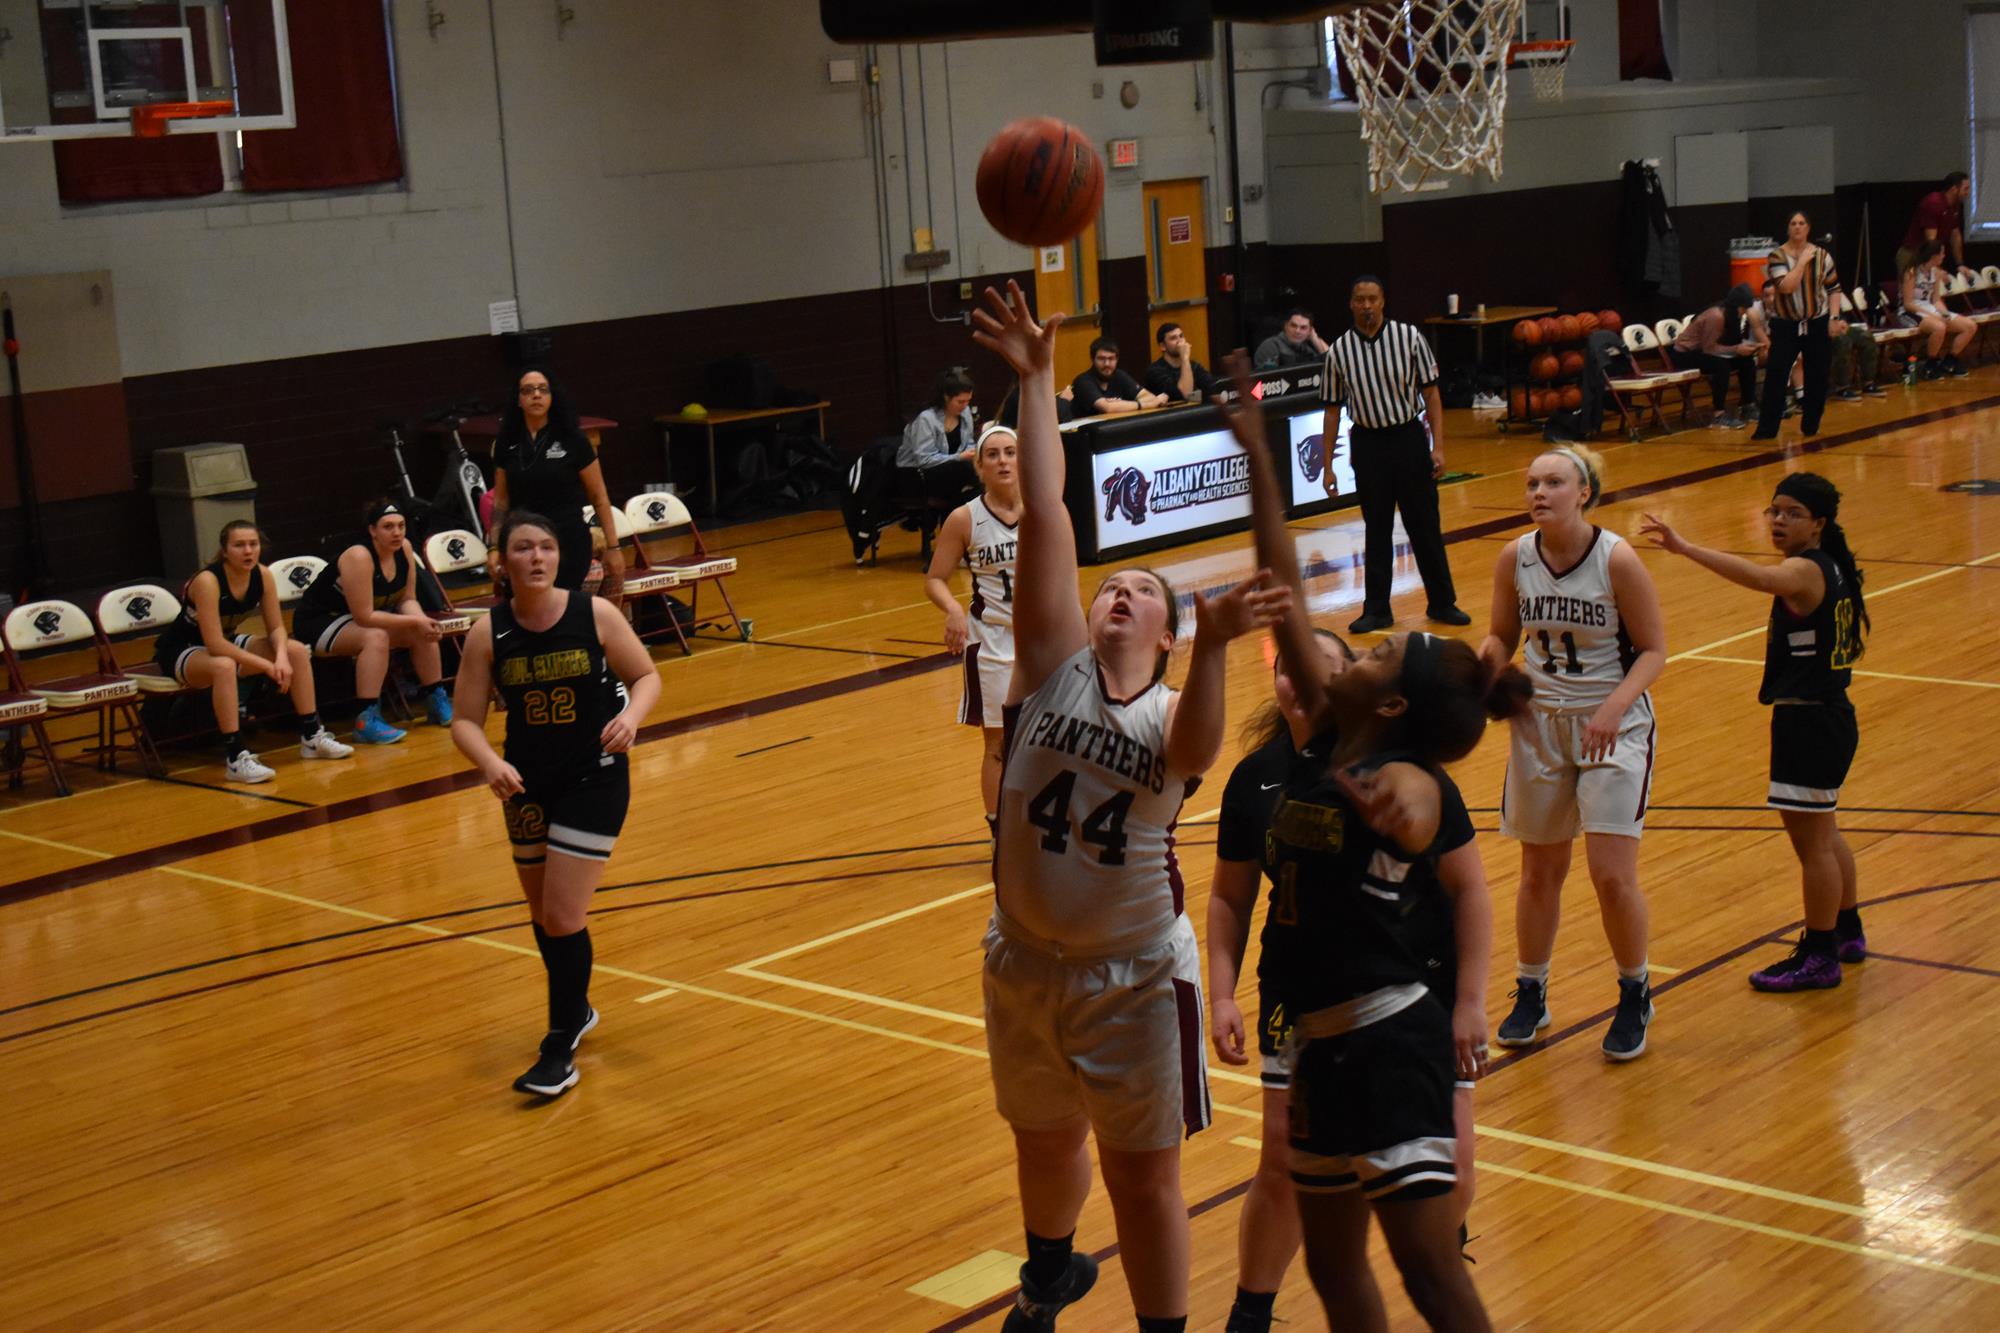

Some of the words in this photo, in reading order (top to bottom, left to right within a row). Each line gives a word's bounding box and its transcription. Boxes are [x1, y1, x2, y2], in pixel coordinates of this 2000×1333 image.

[1262, 380, 1281, 396] POSS
[1153, 465, 1203, 498] ALBANY
[1203, 455, 1250, 488] COLLEGE
[1156, 492, 1190, 512] PHARMACY
[1198, 486, 1222, 502] HEALTH
[1222, 480, 1250, 497] SCIENCES
[700, 561, 733, 575] PANTHERS
[978, 541, 1018, 568] PANT
[640, 575, 675, 590] PANTHERS
[1520, 595, 1606, 627] PANTHERS
[1537, 629, 1583, 674] 11
[84, 684, 130, 701] PANTHERS
[523, 686, 577, 725] 22
[0, 703, 41, 718] ANTHERS
[1029, 711, 1167, 795] PANTHERS
[504, 802, 546, 840] 22
[1028, 769, 1136, 866] 44
